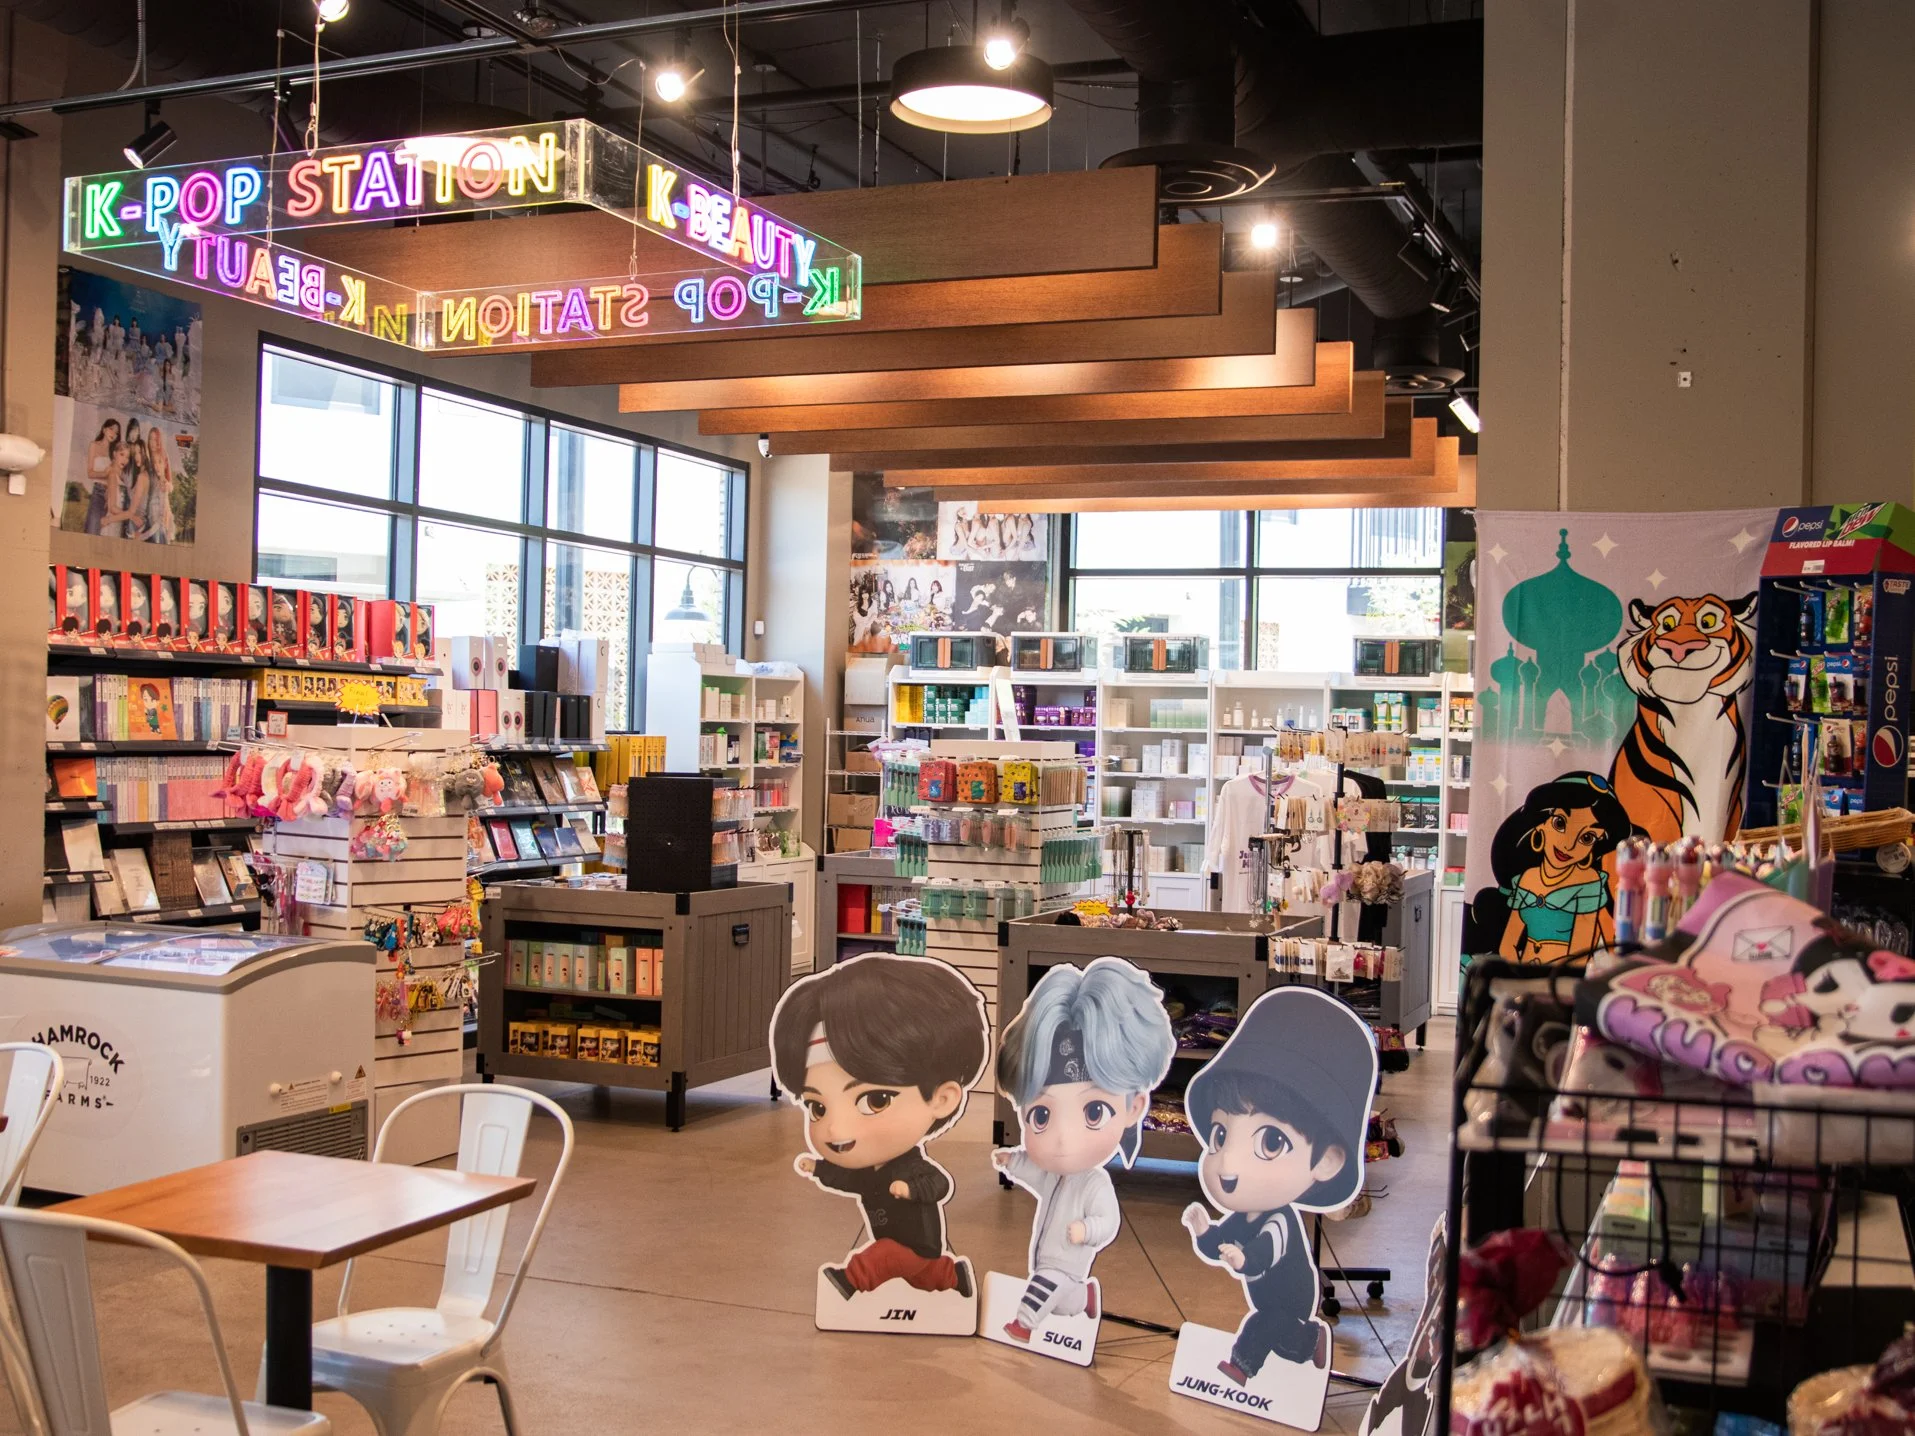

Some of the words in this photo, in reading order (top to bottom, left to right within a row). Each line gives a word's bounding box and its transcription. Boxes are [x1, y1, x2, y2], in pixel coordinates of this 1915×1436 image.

[84, 166, 262, 240] K-POP
[286, 132, 558, 218] STATION
[647, 164, 816, 287] K-BEAUTY
[1797, 519, 1825, 532] pepsi
[1789, 540, 1822, 549] FLAVORED
[1822, 540, 1833, 548] LIP
[1833, 539, 1856, 547] BALM!
[1884, 655, 1899, 721] pepsi
[32, 1025, 125, 1075] HAMROCK
[90, 1075, 111, 1086] 1922
[880, 1308, 917, 1321] JIN
[1043, 1330, 1083, 1352] SUGA
[1176, 1375, 1273, 1411] JUNG-KOOK
